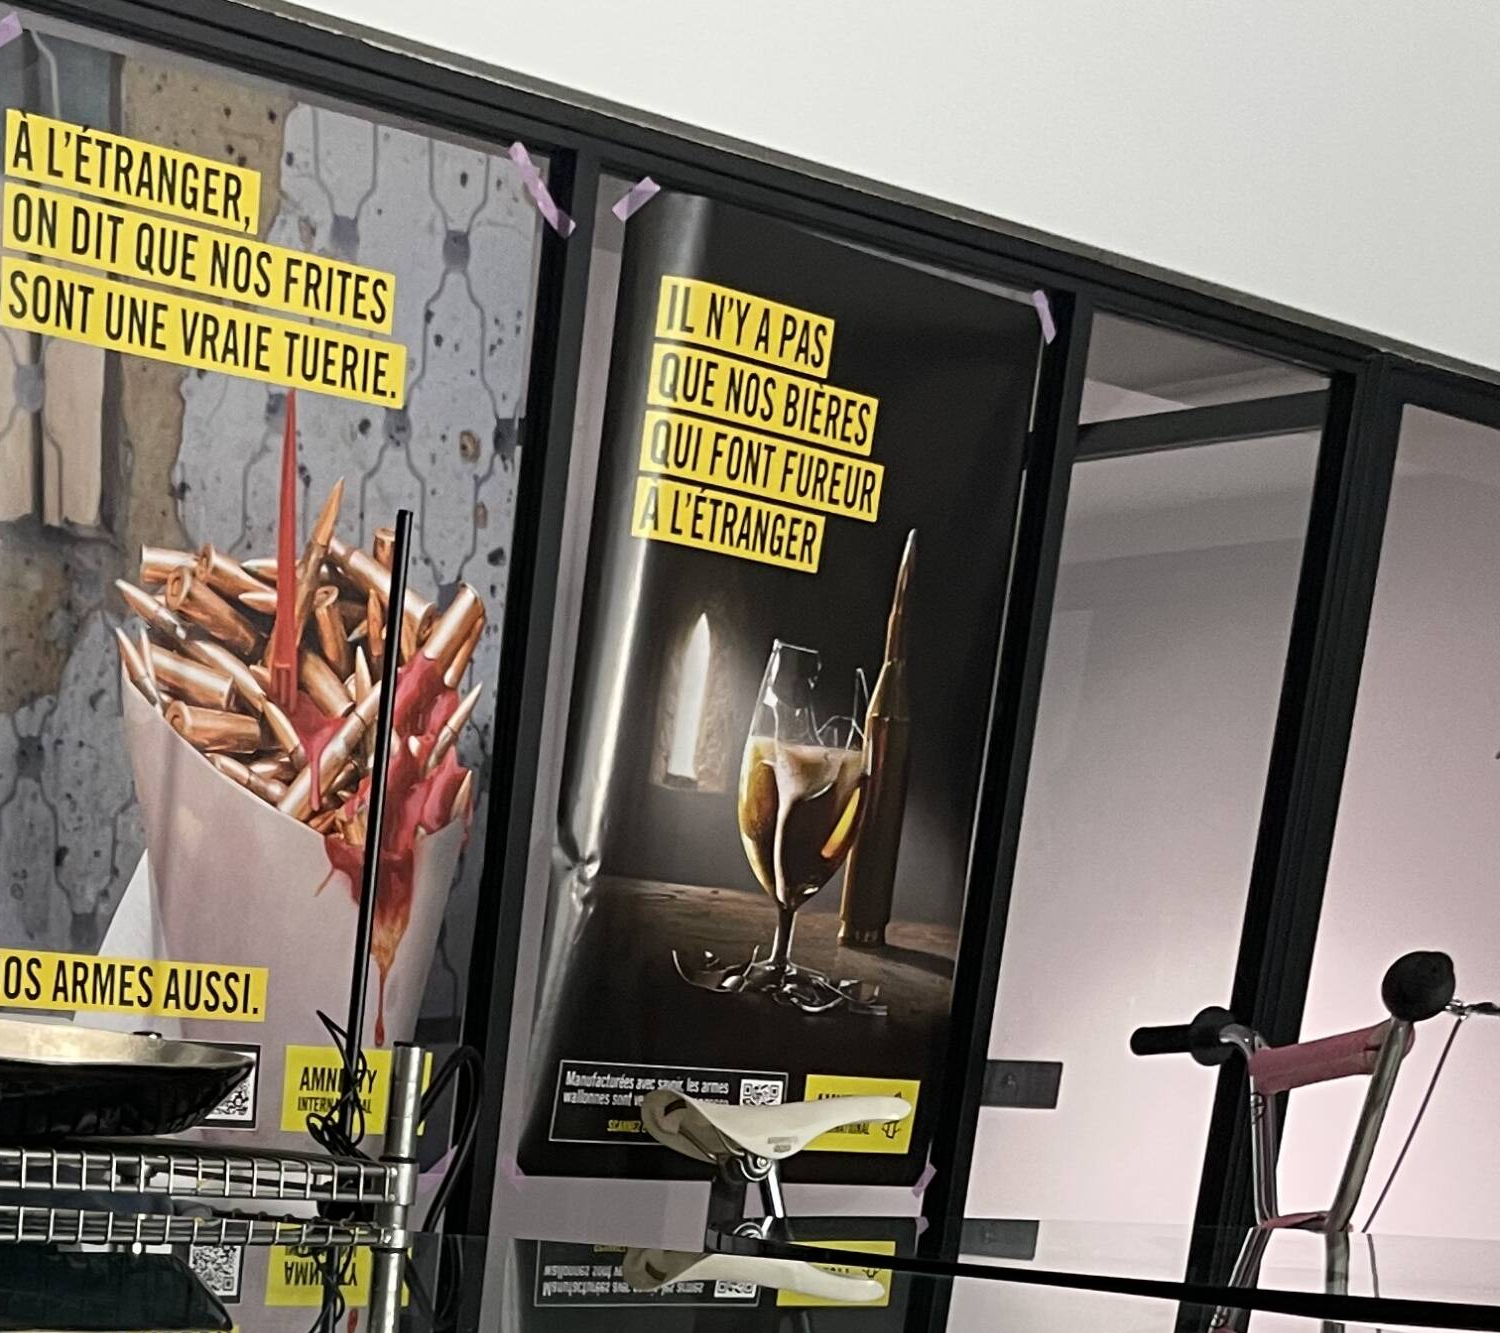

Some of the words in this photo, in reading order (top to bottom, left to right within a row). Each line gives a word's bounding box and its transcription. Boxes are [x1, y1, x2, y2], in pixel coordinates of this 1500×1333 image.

[12, 112, 33, 172] À
[12, 192, 61, 248] ON
[72, 205, 124, 263] DIT
[135, 223, 198, 283] QUE
[211, 239, 271, 300] NOS
[284, 257, 388, 325] FRITES
[9, 269, 93, 334] SONT
[105, 291, 167, 352] UNE
[181, 307, 270, 373] VRAIE
[285, 330, 398, 399] TUERIE.
[667, 284, 695, 335] IL
[754, 307, 770, 354] A
[778, 317, 828, 368] PAS
[658, 351, 719, 407] QUE
[725, 366, 776, 421] NOS
[783, 381, 871, 446] BIÈRES
[650, 418, 703, 472] QUI
[709, 432, 776, 489] FONT
[780, 450, 876, 514] FUREUR
[52, 961, 154, 1009] ARMES
[163, 969, 260, 1016] AUSSI.
[563, 1089, 610, 1105] wallonnes
[611, 1091, 633, 1107] sont
[565, 1070, 634, 1089] Manufacturées
[636, 1078, 655, 1090] avec
[686, 1077, 699, 1093] les
[701, 1081, 729, 1095] armes
